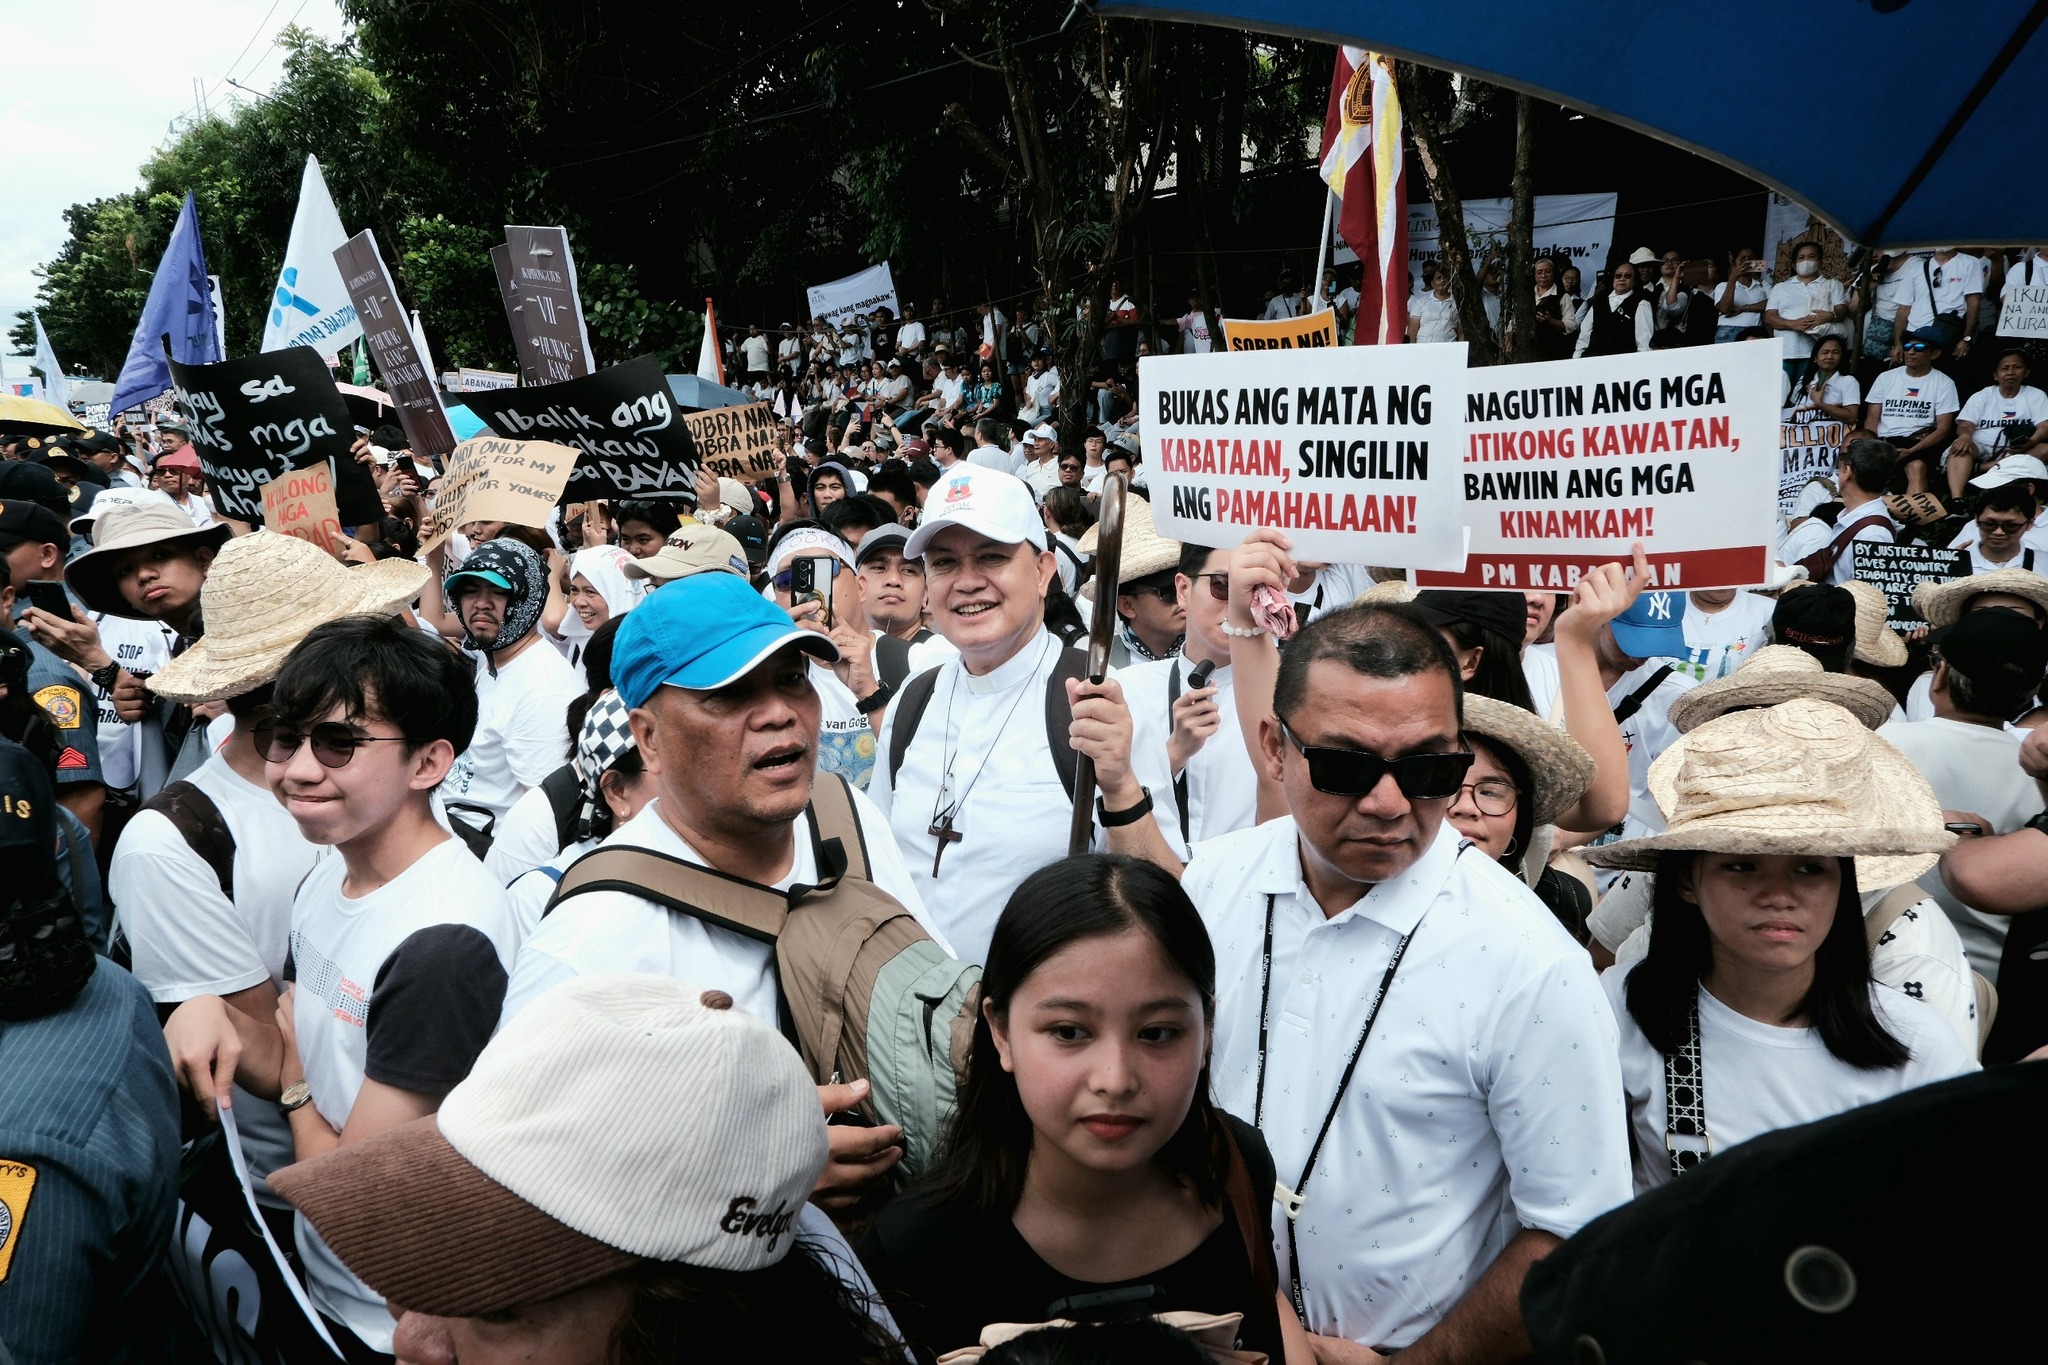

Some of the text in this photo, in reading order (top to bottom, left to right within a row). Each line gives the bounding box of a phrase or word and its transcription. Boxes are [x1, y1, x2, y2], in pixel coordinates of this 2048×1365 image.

[2006, 304, 2022, 314] NA
[2013, 288, 2048, 303] IKU
[536, 295, 557, 325] VII
[538, 335, 574, 363] HUWAG
[1296, 326, 1331, 349] NA!
[240, 375, 296, 403] sa
[1464, 372, 1726, 423] NAGUTIN ANG MGA
[495, 390, 673, 437] Ibalik ang
[1158, 384, 1432, 425] BUKAS ANG MATA NG
[1885, 399, 1932, 410] PILIPINAS
[743, 406, 773, 432] NA!
[250, 414, 338, 456] mga
[479, 441, 526, 456] ONLY
[694, 429, 774, 458] OBRA NA!
[1583, 416, 1740, 457] KAWATAN,
[1780, 423, 1851, 449] ILLIO
[439, 455, 556, 493] IGHTING FOR MY
[706, 449, 779, 479] BRA NA
[1160, 438, 1429, 484] KABATAAN, SINGILIN
[266, 472, 328, 513] IKULONG
[509, 482, 558, 503] YOURS
[1464, 462, 1695, 501] BAWIIN ANG MGA
[278, 501, 310, 527] MGA
[1173, 485, 1417, 534] ANG PAMAHALAAN!
[1499, 507, 1654, 539] KINAMKAM!
[1854, 556, 1950, 573] GIVES A COUNTRY
[1855, 543, 1960, 561] BY JUSTICE A KING
[1481, 562, 1681, 587] PM KABAN
[1885, 583, 1908, 594] ARE
[1648, 591, 1671, 620] NY
[117, 643, 144, 660] STOP
[826, 716, 868, 730] van Gog
[0, 1163, 28, 1179] Y'S
